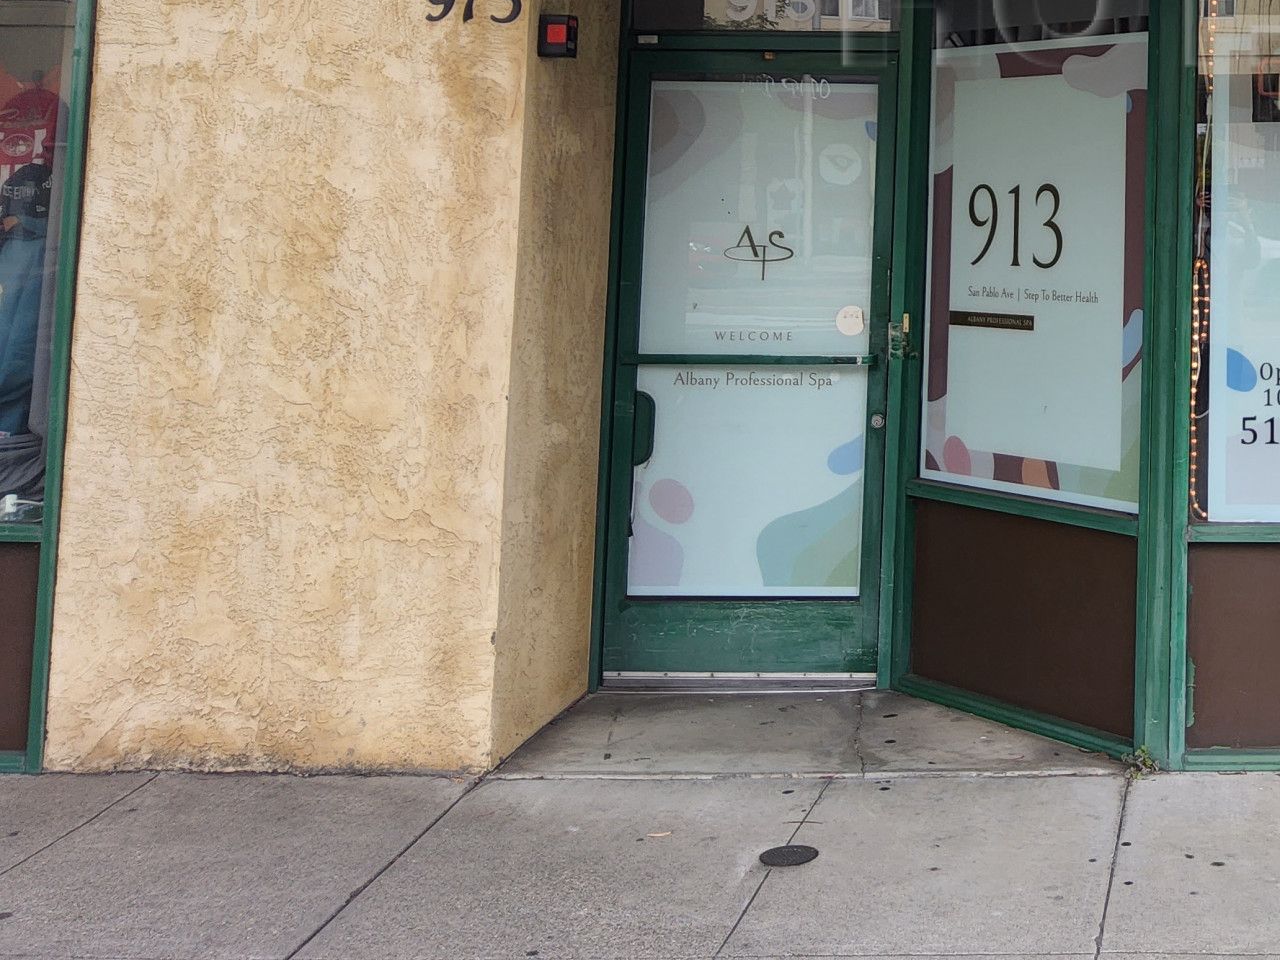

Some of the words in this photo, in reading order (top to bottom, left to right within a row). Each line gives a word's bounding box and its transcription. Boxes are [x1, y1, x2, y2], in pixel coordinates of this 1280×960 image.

[969, 183, 1063, 269] 913
[968, 286, 980, 297] San
[982, 286, 999, 298] Pablo
[1001, 288, 1014, 299] Ave
[1024, 289, 1039, 303] Step
[1041, 290, 1050, 301] To
[1052, 290, 1073, 302] Better
[1075, 291, 1099, 304] Health
[715, 331, 793, 341] WELCOME
[673, 371, 720, 389] Albany
[726, 371, 803, 386] Professional
[808, 372, 832, 389] Spa
